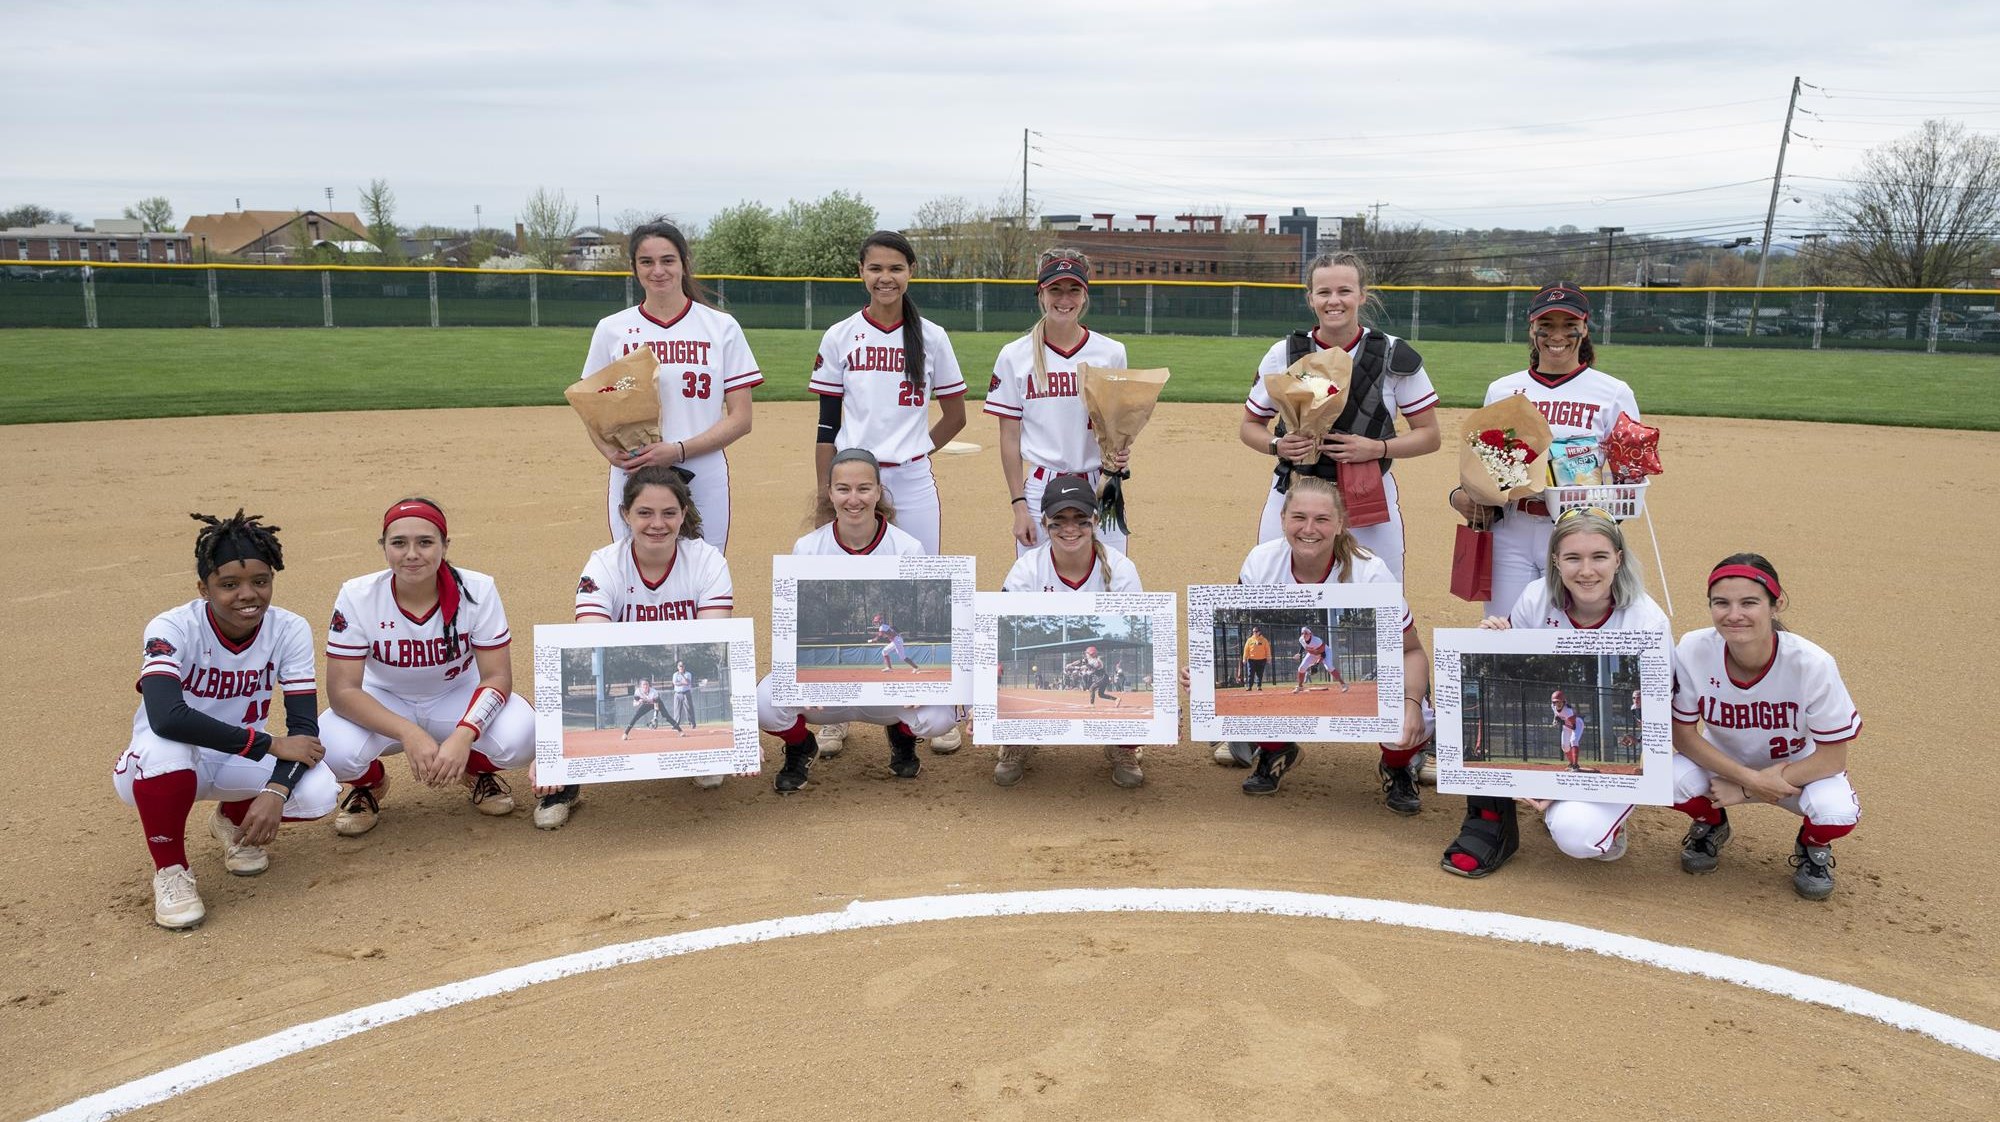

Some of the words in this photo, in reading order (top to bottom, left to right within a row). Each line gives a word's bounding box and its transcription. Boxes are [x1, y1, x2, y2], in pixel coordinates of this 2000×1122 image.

[623, 340, 711, 365] ARIGHT
[847, 346, 907, 372] ALBRIG
[682, 371, 711, 400] 33
[898, 381, 926, 407] 25
[1026, 372, 1079, 399] ABRI
[1531, 401, 1600, 430] RIGHT
[618, 600, 698, 622] BRIGHT
[1698, 696, 1799, 732] ALBRIGHT
[1769, 736, 1807, 760] 23
